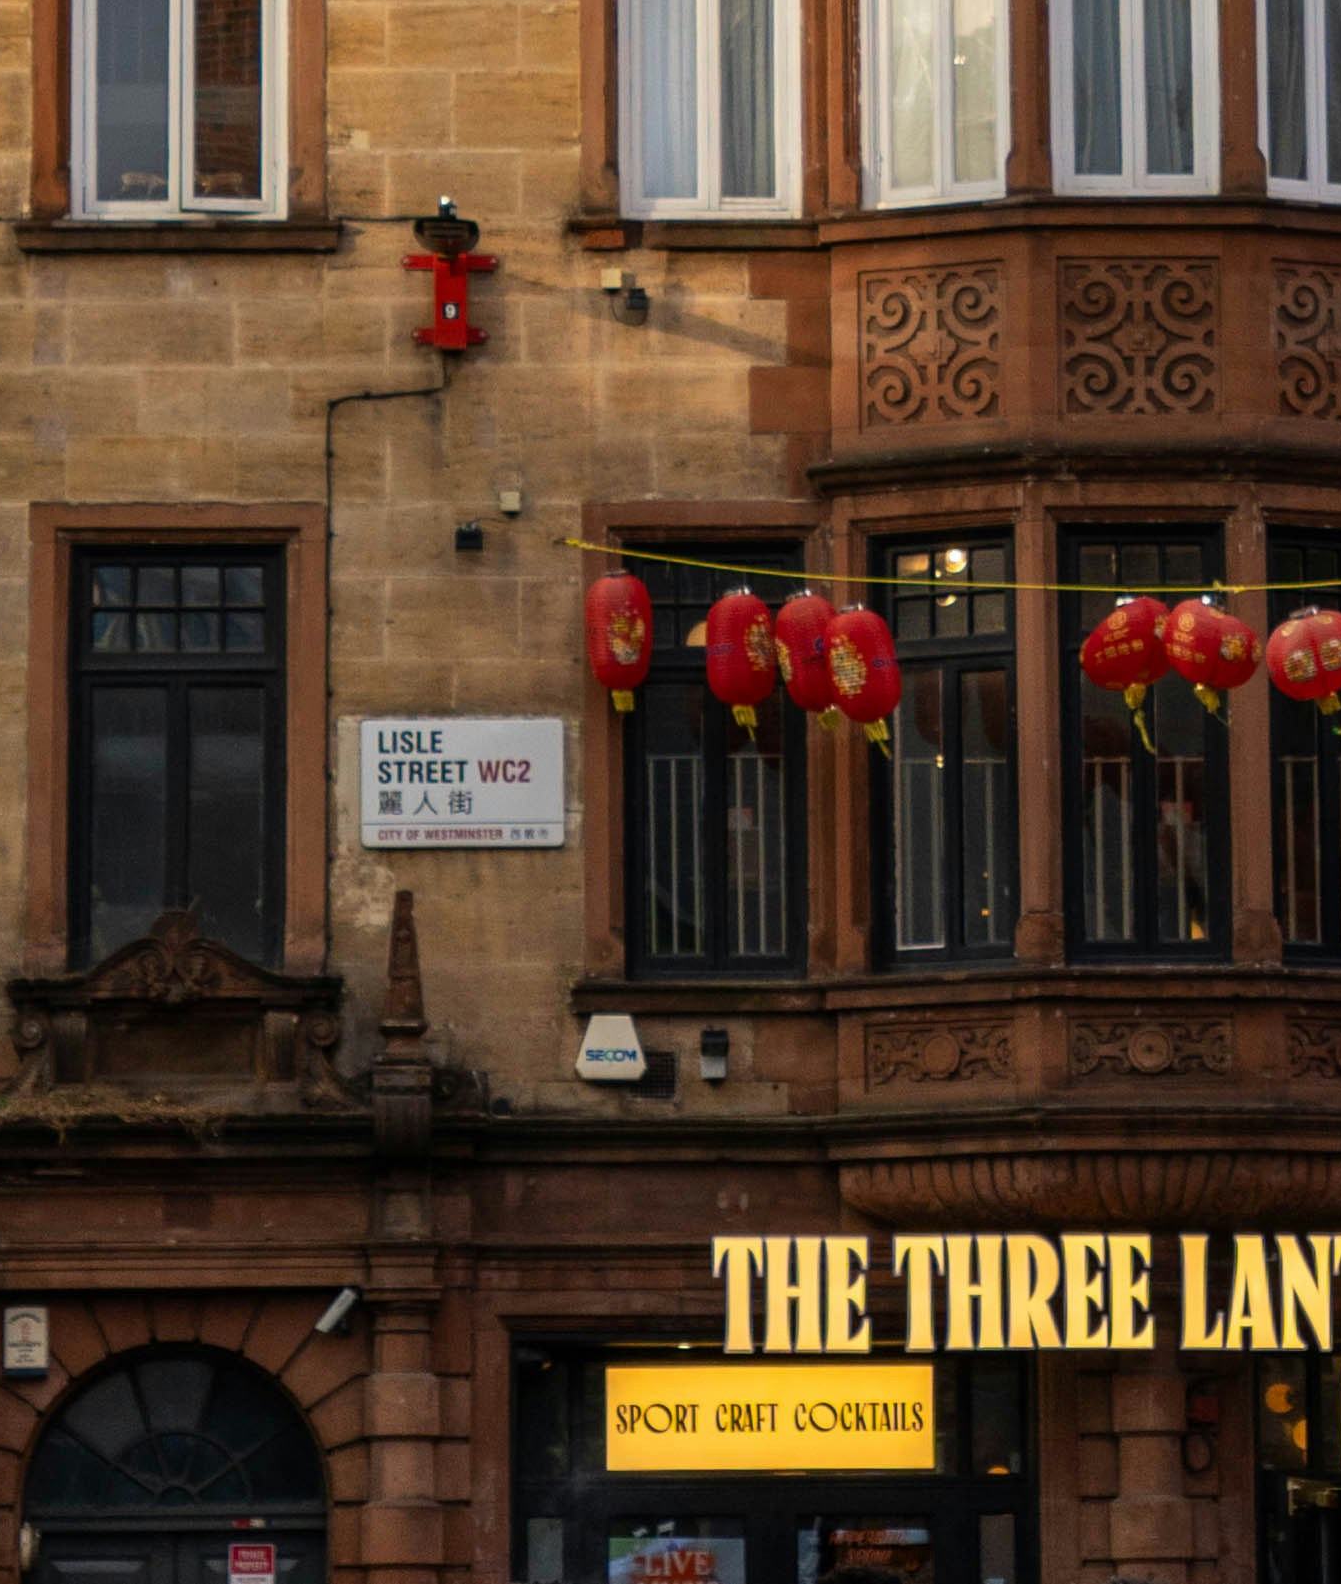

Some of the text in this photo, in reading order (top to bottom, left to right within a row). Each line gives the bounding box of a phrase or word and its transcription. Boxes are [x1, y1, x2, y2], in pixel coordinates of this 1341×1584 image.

[378, 731, 443, 754] LISLE
[378, 760, 532, 784] STREET WC2
[378, 829, 503, 841] CITY OF WESTMINSTER
[585, 1048, 638, 1063] SECOM
[712, 1234, 872, 1354] THE
[892, 1232, 1156, 1351] THREE
[616, 1401, 924, 1434] SPORT CRAFT COCKTAILS
[644, 1550, 709, 1576] LIVE
